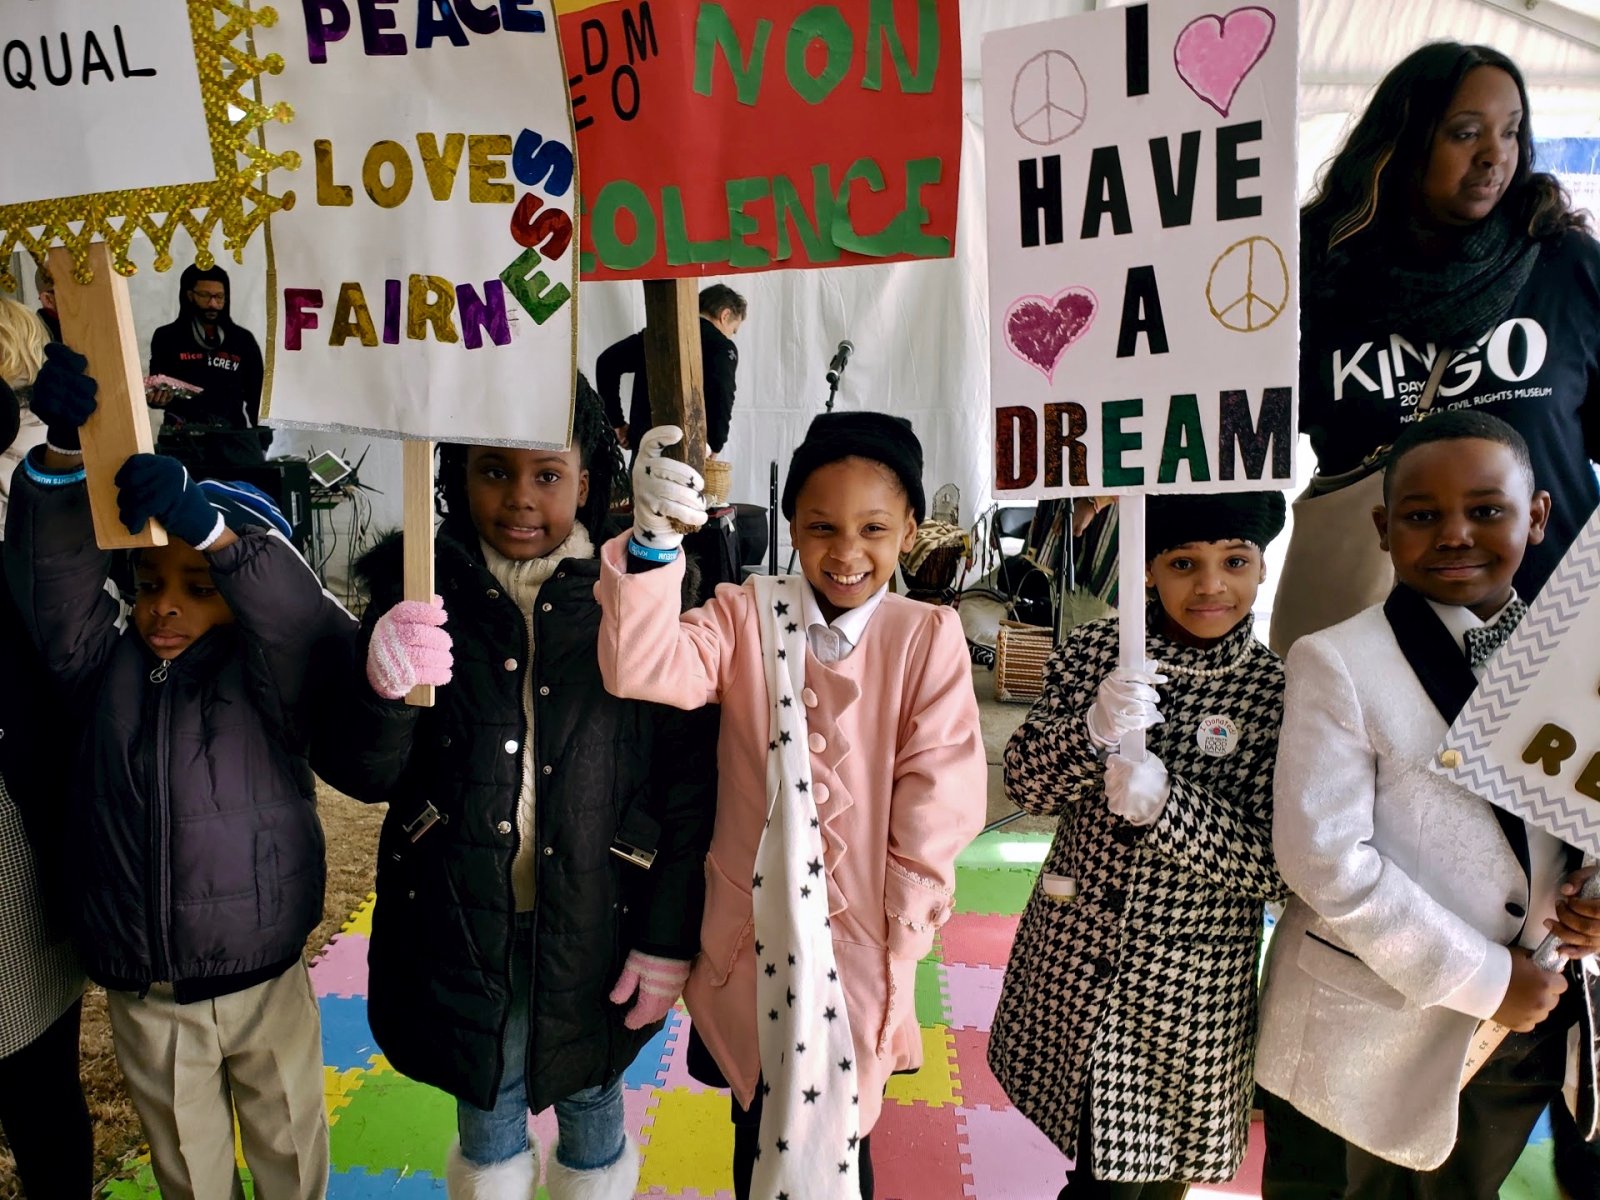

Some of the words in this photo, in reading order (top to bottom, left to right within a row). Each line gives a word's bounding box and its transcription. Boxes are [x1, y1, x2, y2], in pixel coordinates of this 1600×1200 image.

[4, 25, 157, 91] QUAL
[693, 0, 940, 107] NON
[1125, 3, 1149, 98] I
[314, 132, 515, 208] LOVE
[580, 157, 951, 274] OLENCE
[1018, 120, 1263, 248] HAVE
[1116, 265, 1170, 358] A
[1398, 381, 1426, 394] DAY
[1474, 390, 1513, 406] RIGHTS
[1515, 387, 1552, 399] MUSEUM
[995, 386, 1293, 490] DREAM
